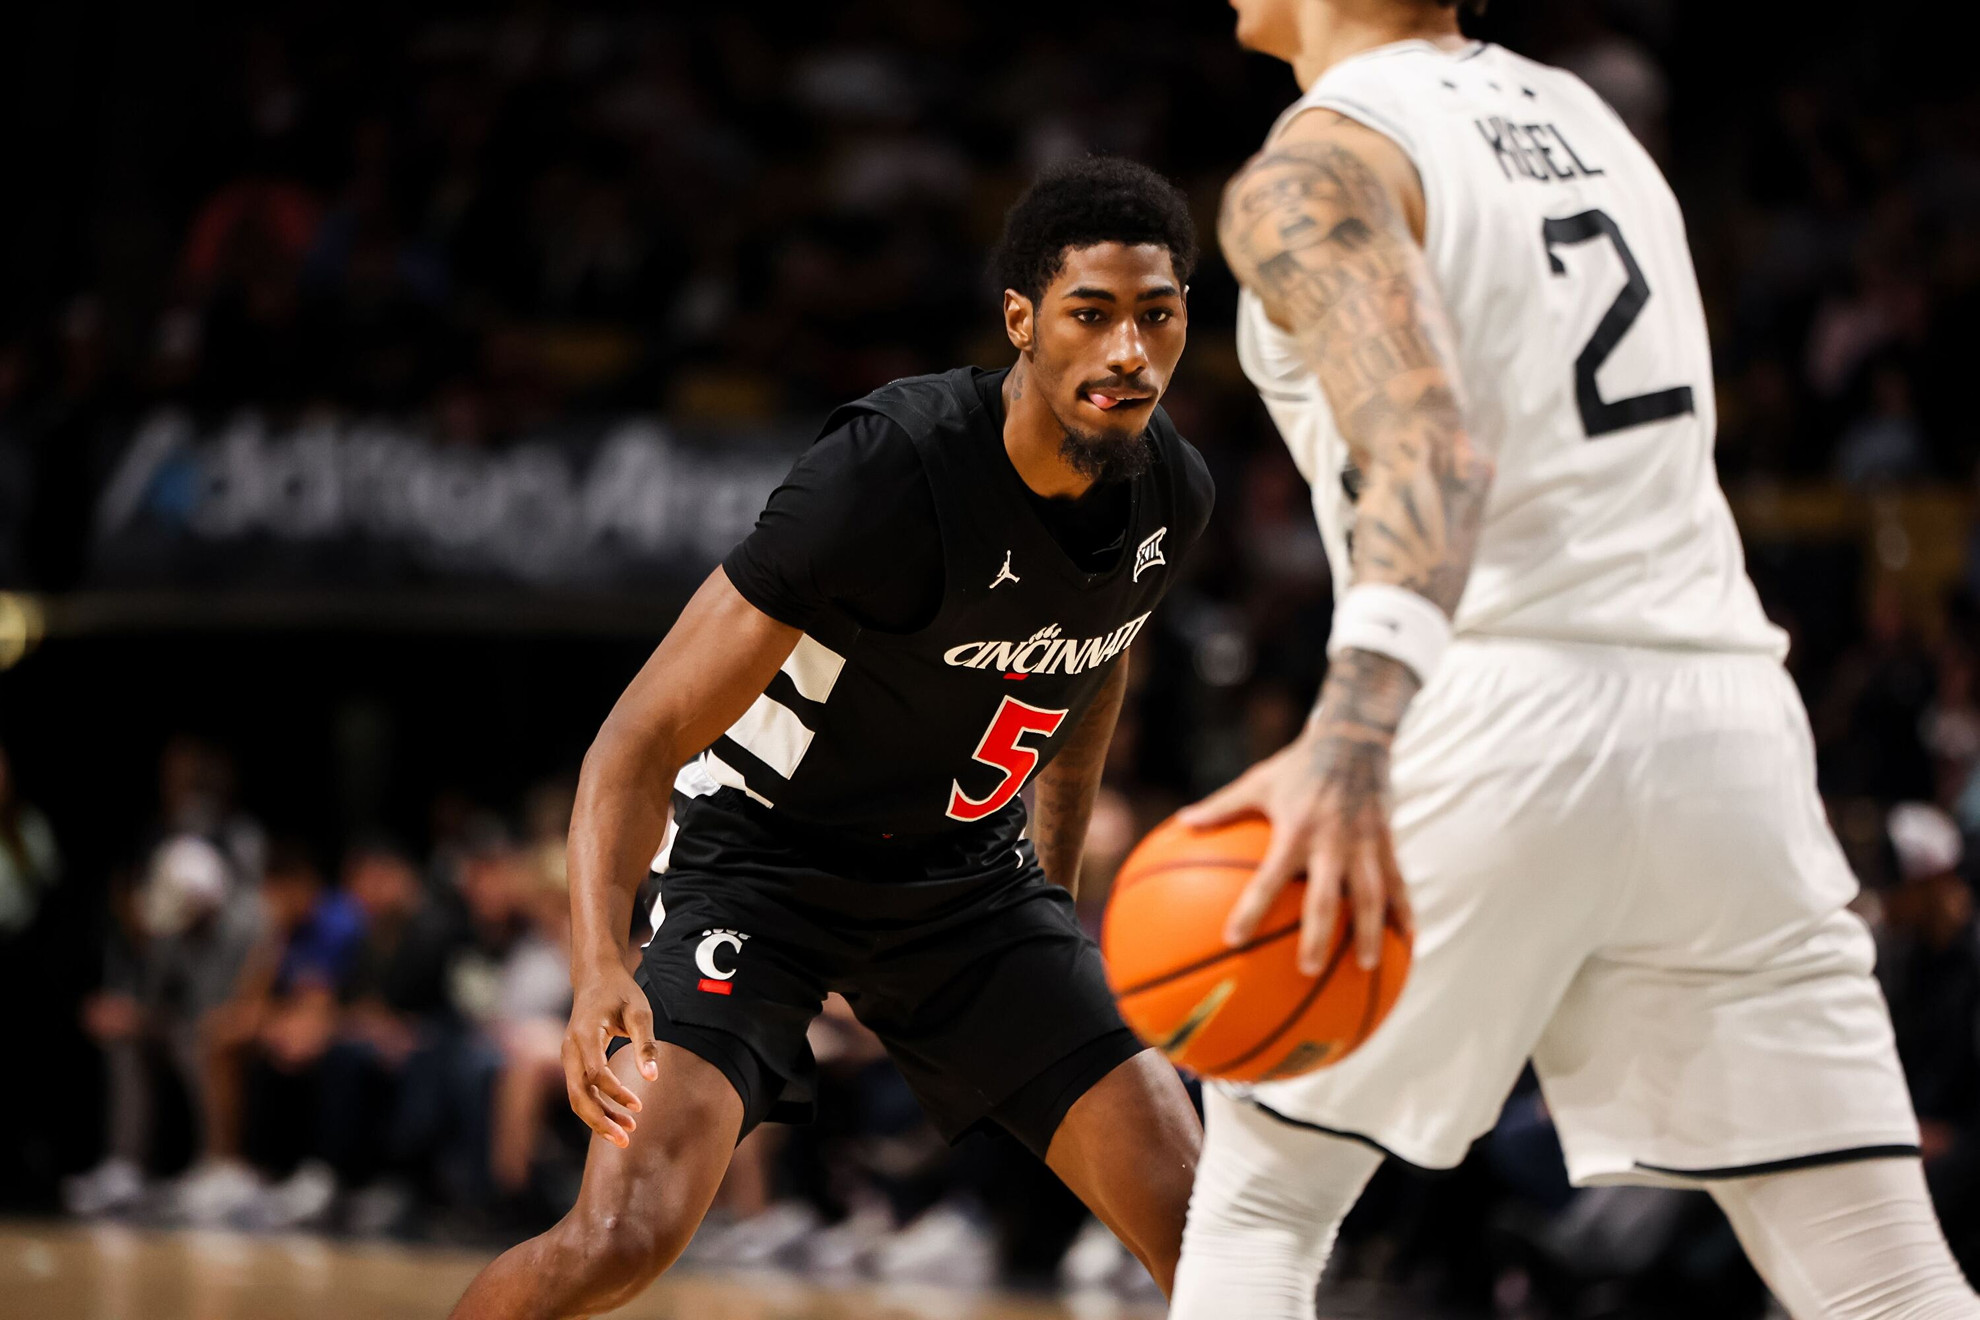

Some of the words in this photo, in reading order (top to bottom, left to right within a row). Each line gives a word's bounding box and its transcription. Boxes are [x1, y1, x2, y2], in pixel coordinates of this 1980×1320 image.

[1542, 209, 1695, 439] 2
[943, 611, 1152, 675] CINCINNATI
[945, 695, 1069, 822] 5
[695, 932, 743, 980] C
